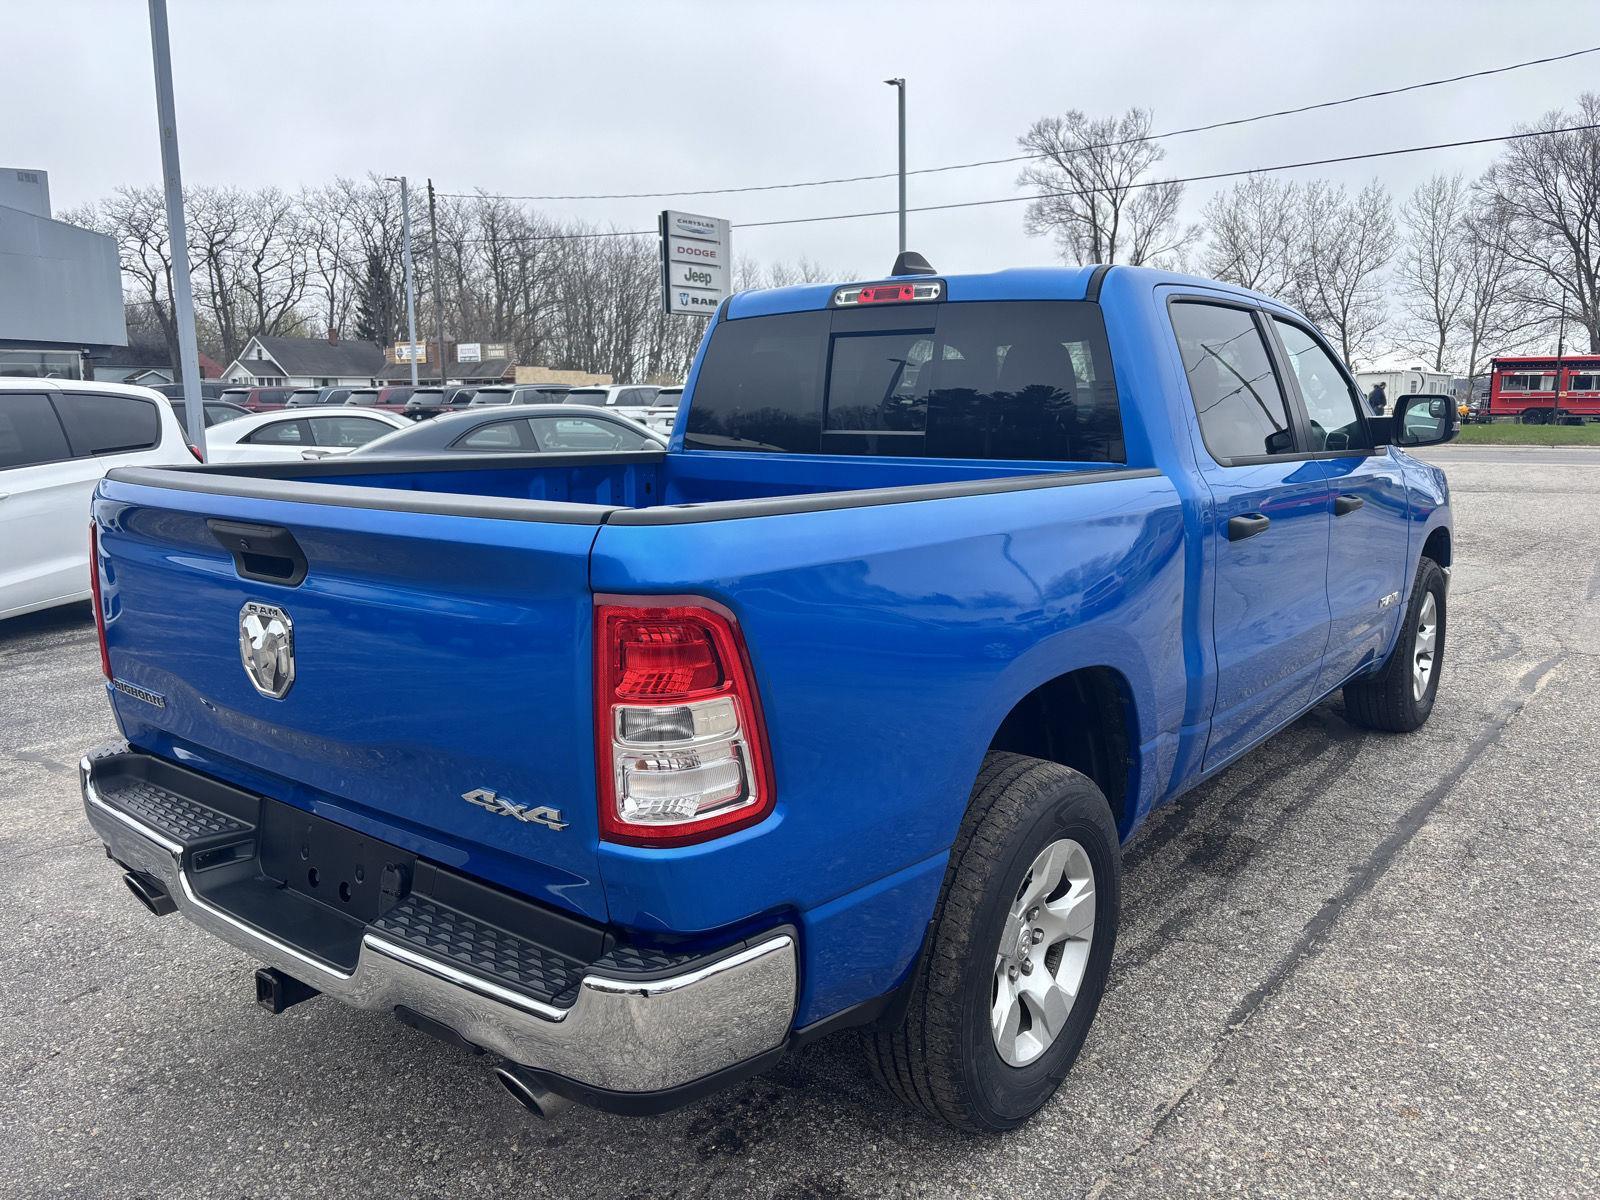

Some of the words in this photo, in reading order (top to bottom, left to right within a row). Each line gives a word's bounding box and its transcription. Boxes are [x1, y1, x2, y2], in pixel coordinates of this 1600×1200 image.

[677, 218, 715, 228] CHRYSLER
[677, 246, 717, 258] DODGE
[684, 267, 712, 286] Jeep
[691, 297, 718, 306] RAM
[248, 604, 278, 616] RAM
